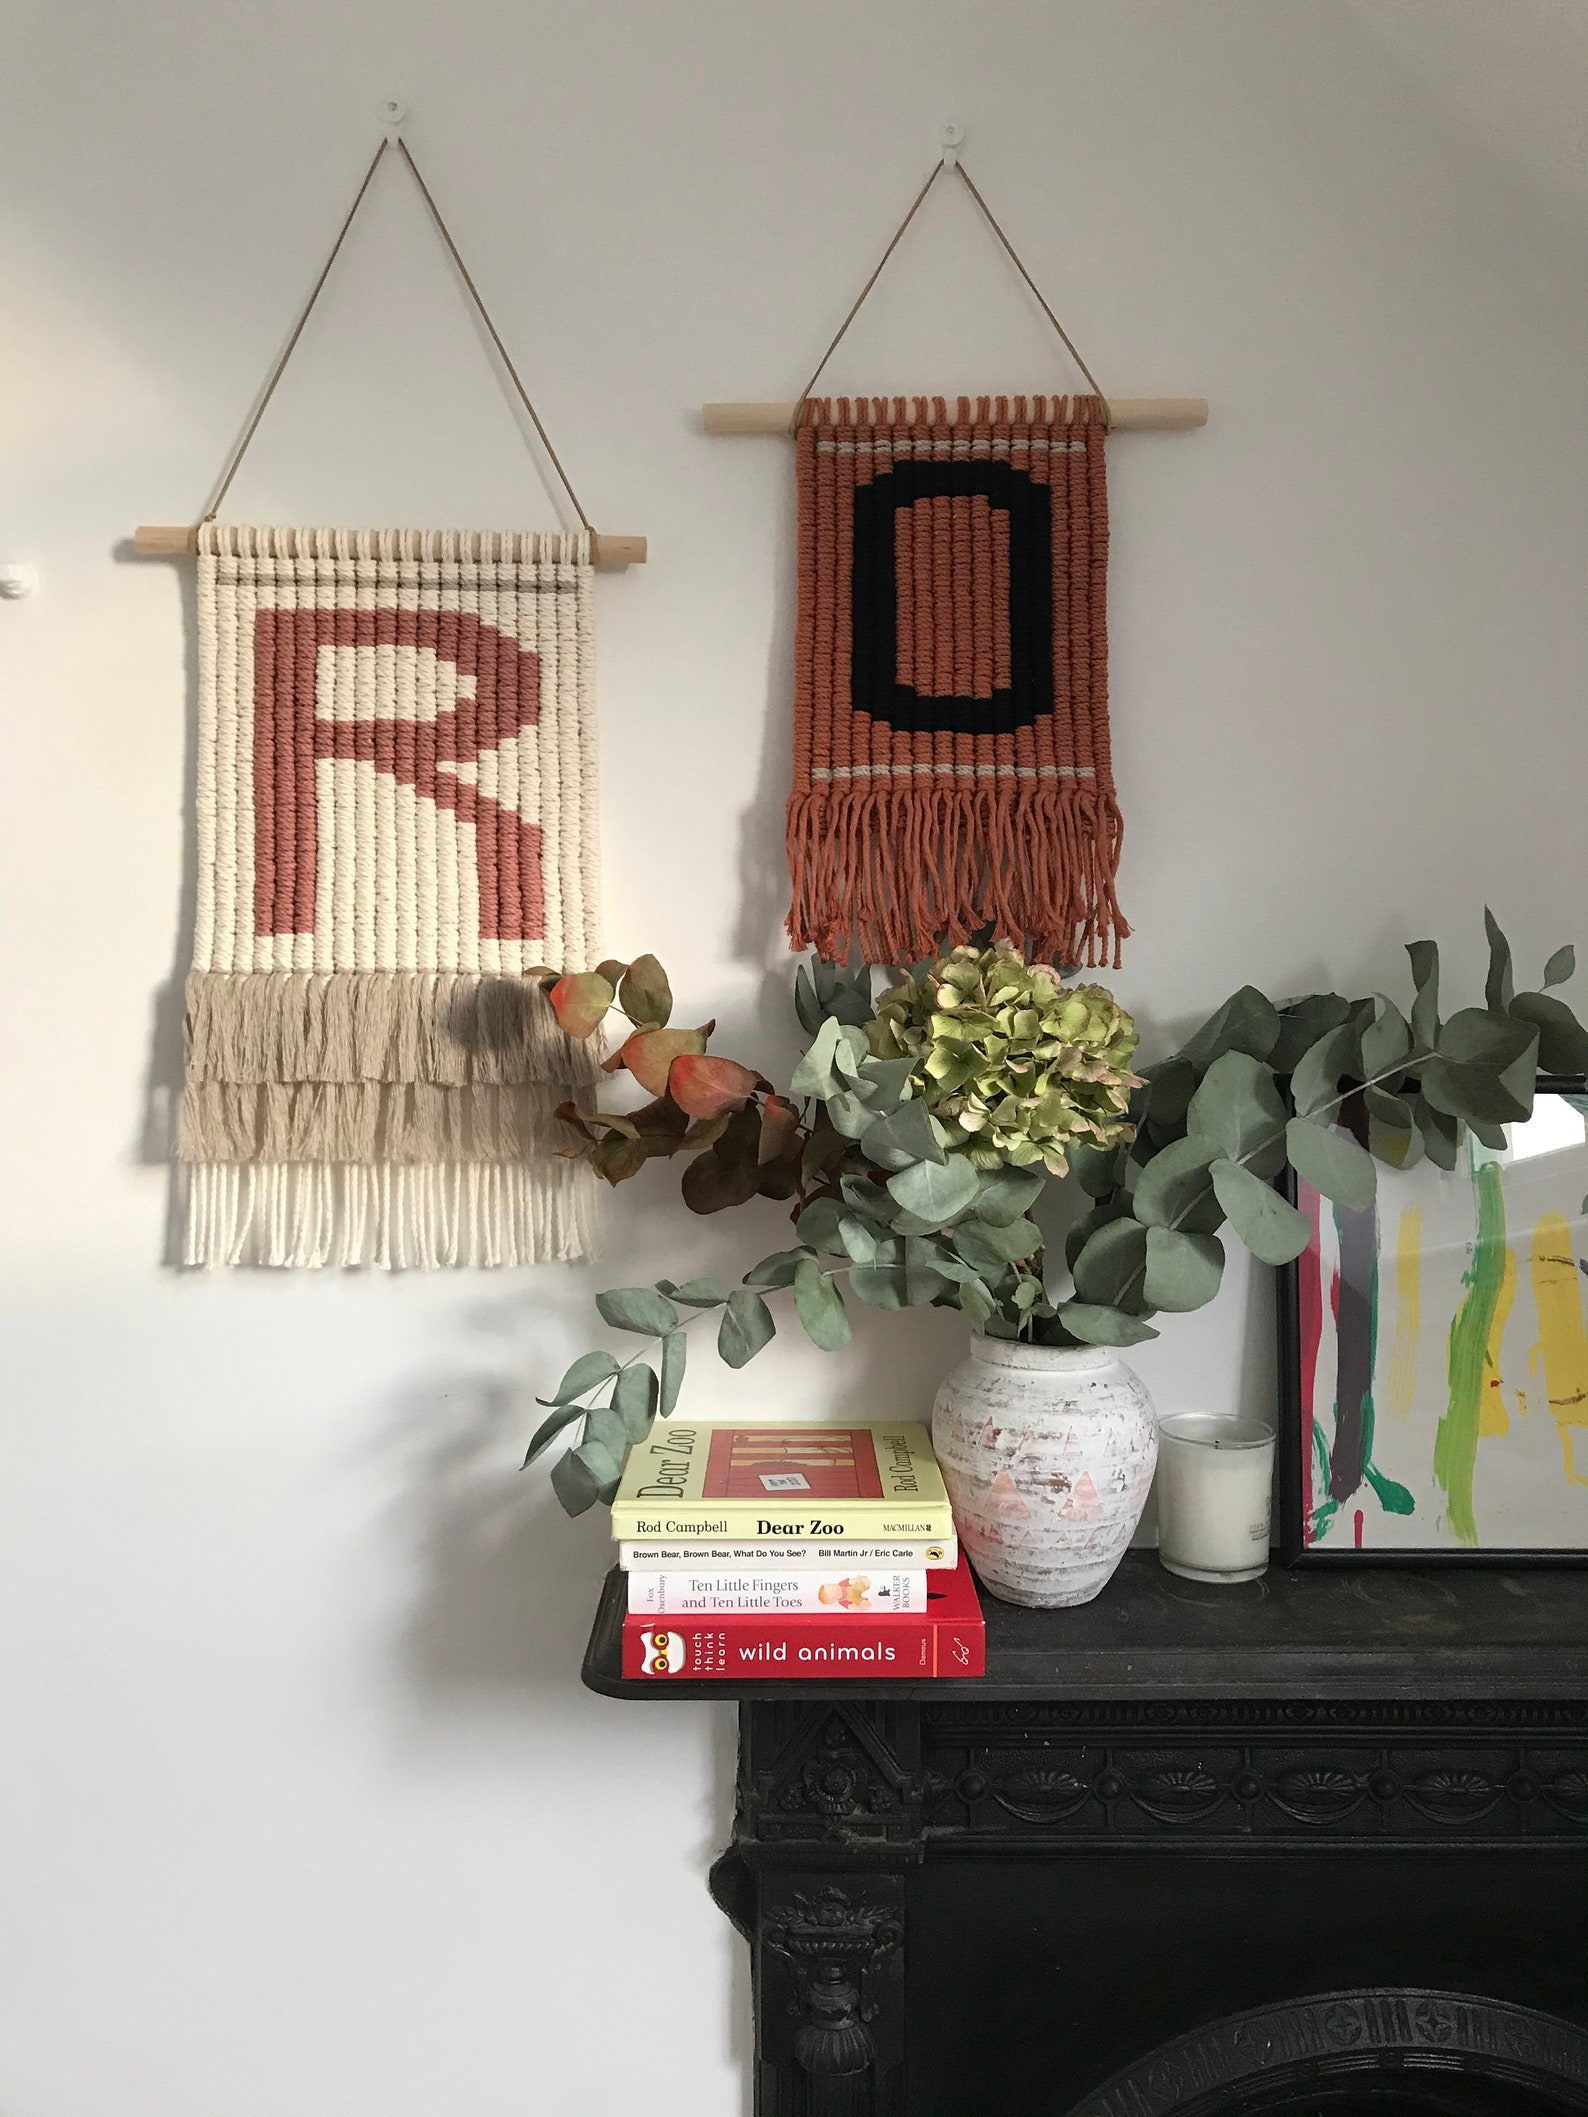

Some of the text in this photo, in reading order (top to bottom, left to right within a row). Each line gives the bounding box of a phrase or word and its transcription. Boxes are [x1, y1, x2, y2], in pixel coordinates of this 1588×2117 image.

[255, 608, 546, 939] R
[636, 1429, 697, 1498] Dear Zoo
[883, 1435, 919, 1492] Rod Campbell
[636, 1520, 926, 1535] Rod Campbell Dear Zoo MACMILLAN
[633, 1551, 659, 1559] Brown
[661, 1551, 682, 1560] Bear,
[711, 1550, 732, 1559] Bear,
[733, 1550, 754, 1558] What
[756, 1550, 768, 1558] Do
[769, 1550, 785, 1558] You
[786, 1550, 807, 1558] See?
[818, 1549, 832, 1557] Bill
[833, 1549, 858, 1557] Martin
[860, 1549, 869, 1557] Jr
[875, 1549, 891, 1557] Eric
[892, 1549, 913, 1557] Carle
[646, 1588, 655, 1603] Fox
[658, 1574, 667, 1614] Oxenbury
[689, 1578, 799, 1594] Ten Little Fingers
[682, 1596, 803, 1608] and Ten Little Toes
[692, 1632, 702, 1671] touch
[704, 1632, 714, 1671] think
[716, 1632, 726, 1671] learn
[739, 1641, 896, 1661] wild animals
